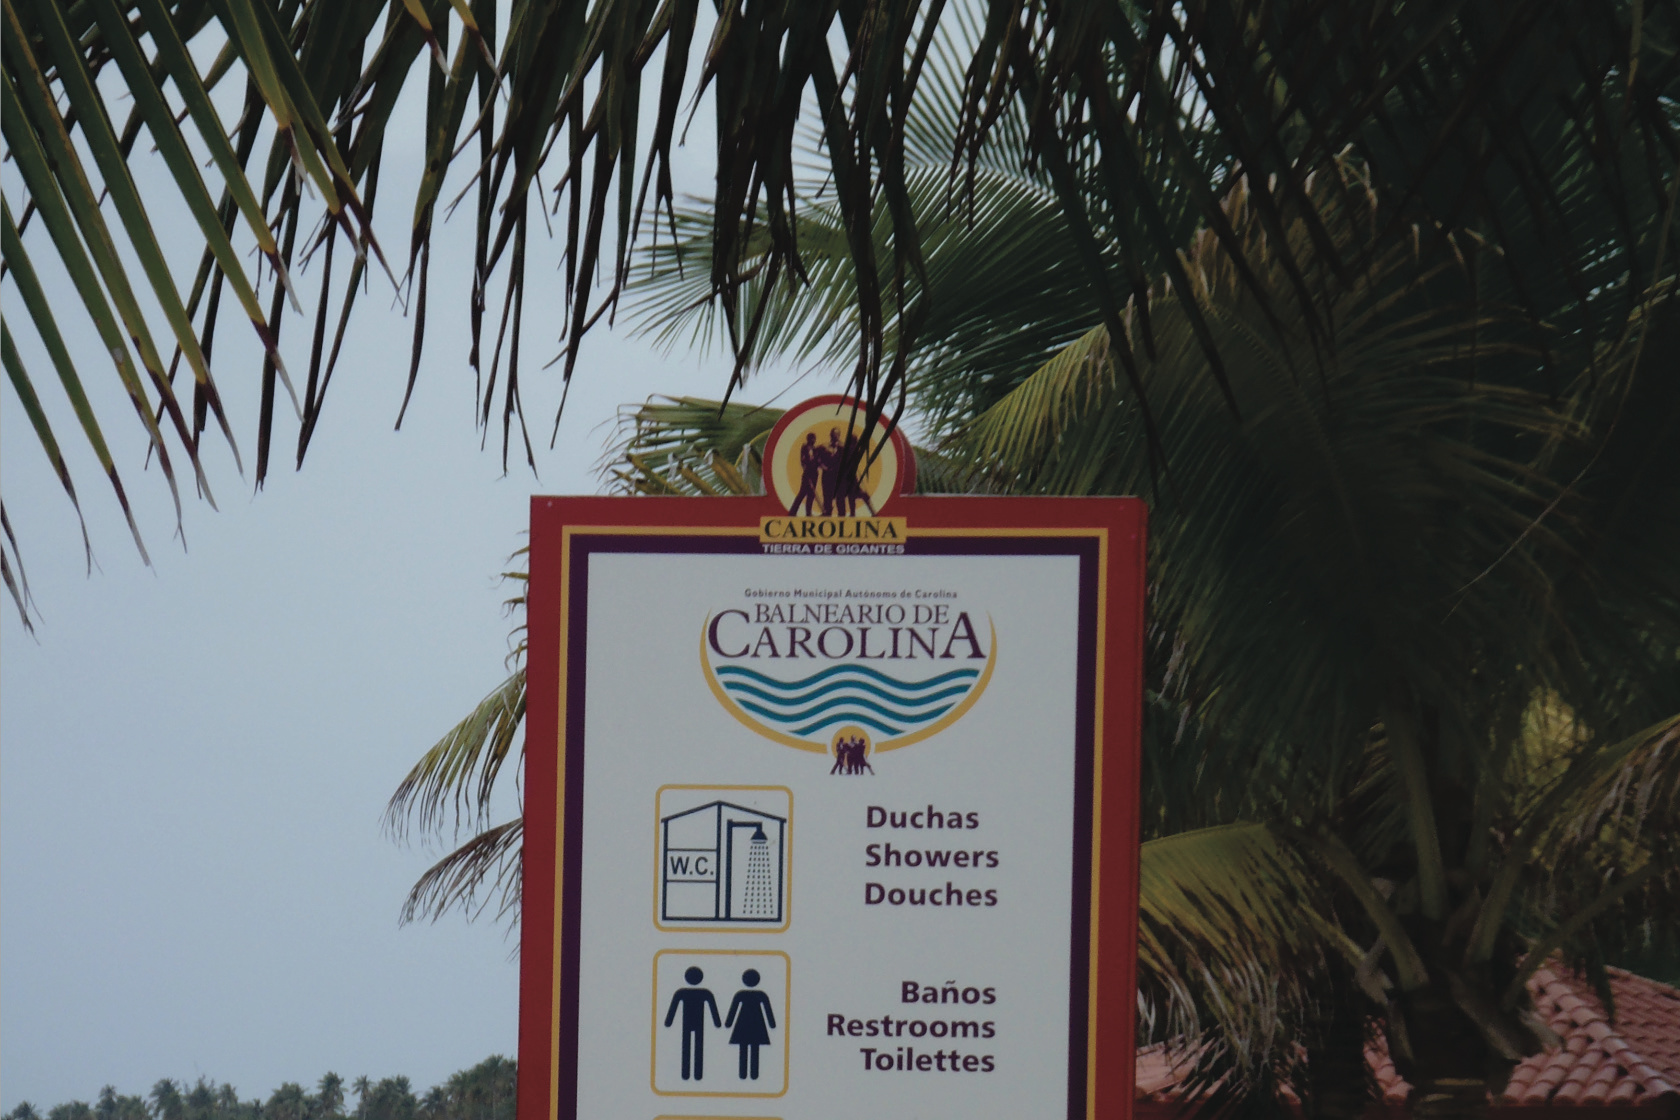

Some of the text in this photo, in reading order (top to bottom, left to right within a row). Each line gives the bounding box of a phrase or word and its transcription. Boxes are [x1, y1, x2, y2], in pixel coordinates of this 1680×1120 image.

[764, 519, 898, 539] CAROLINA
[762, 544, 905, 555] TIERRA DE GIGANTES
[744, 588, 791, 599] Gobierno
[794, 589, 842, 600] Municipal
[900, 589, 912, 599] de
[914, 589, 958, 599] Carolina
[754, 603, 949, 625] BALNEARIO DE
[708, 609, 987, 660] CAROLINA
[866, 805, 980, 829] Duchas
[670, 856, 714, 876] W.C.
[865, 843, 999, 868] Showers
[865, 882, 998, 907] Douches
[901, 980, 997, 1005] Baños
[826, 1013, 996, 1039] Restrooms
[860, 1047, 996, 1073] Toilettes
